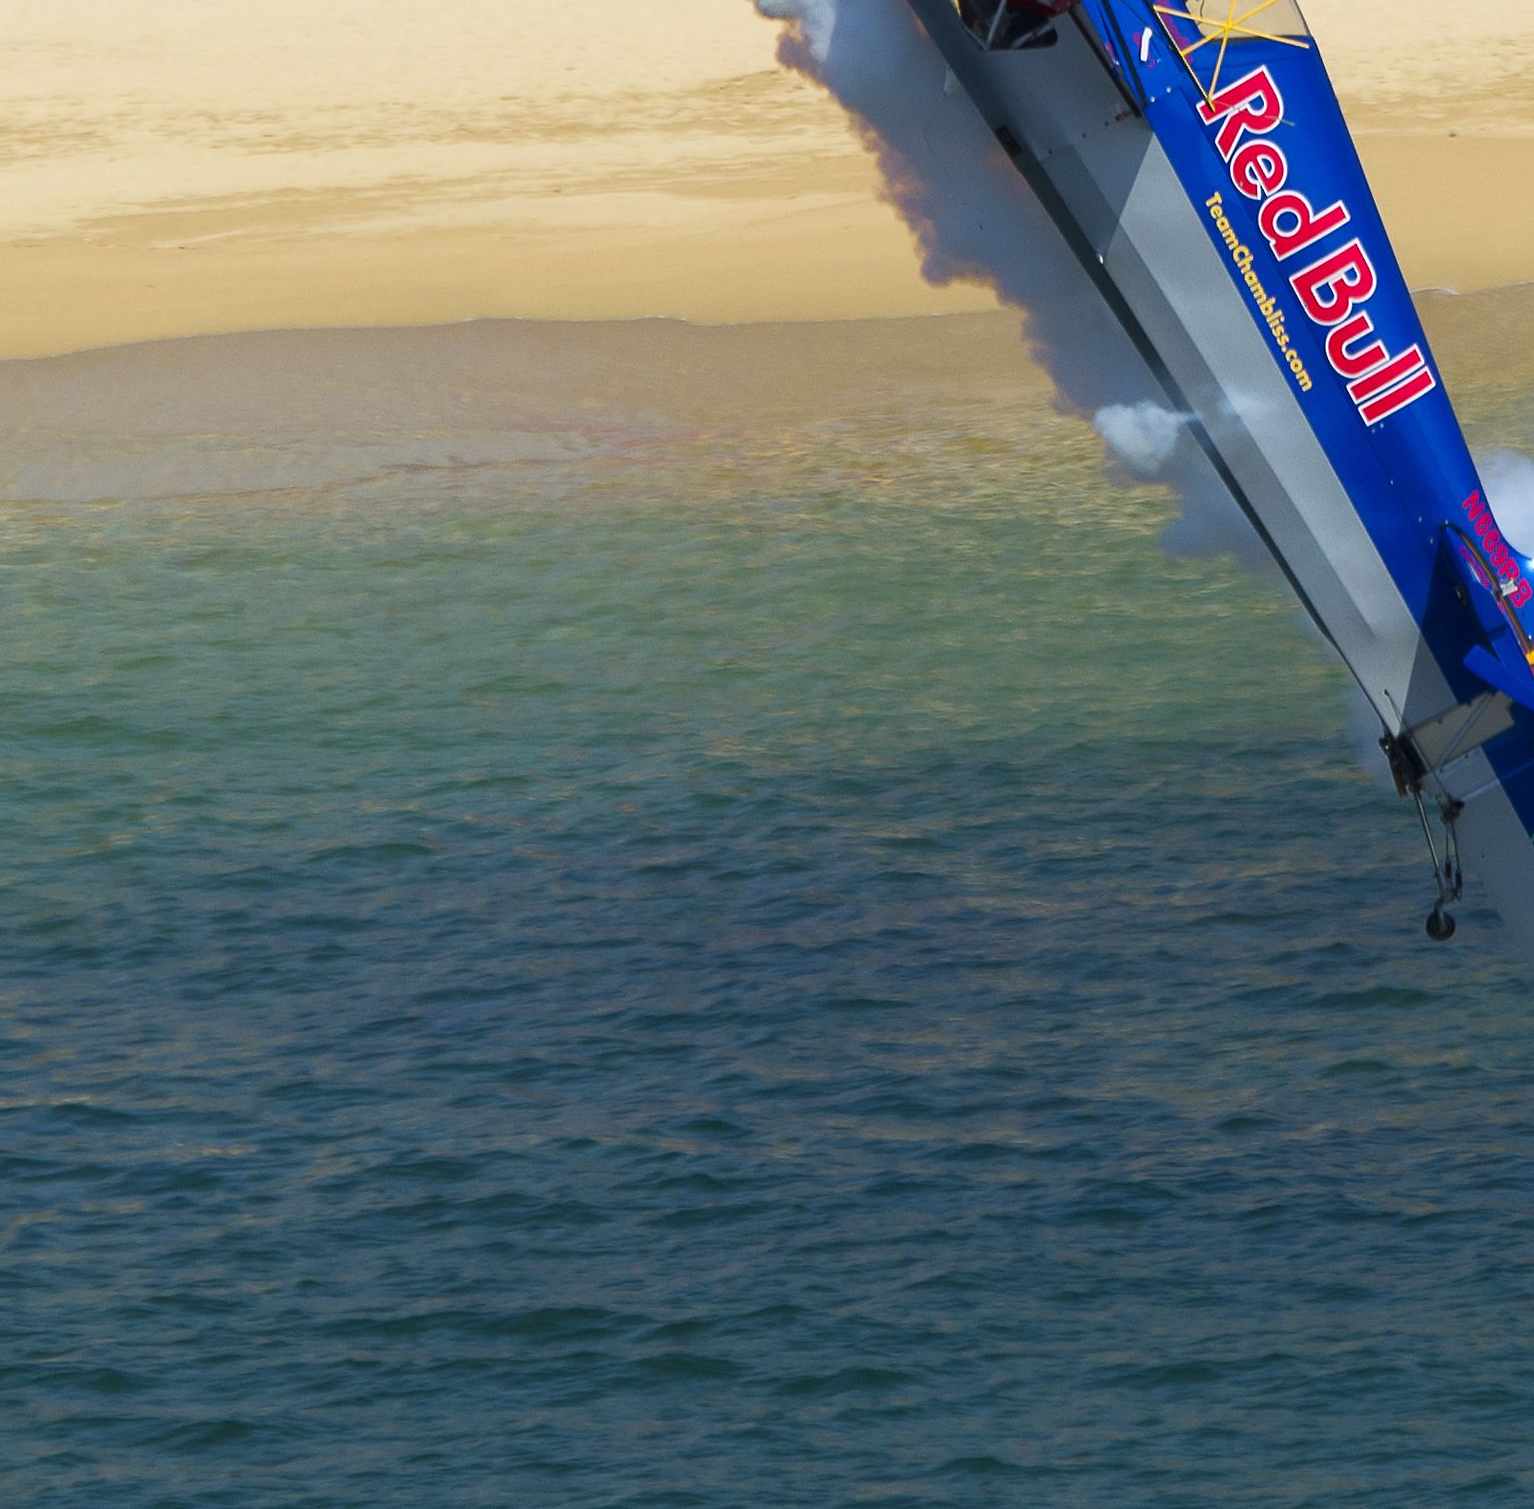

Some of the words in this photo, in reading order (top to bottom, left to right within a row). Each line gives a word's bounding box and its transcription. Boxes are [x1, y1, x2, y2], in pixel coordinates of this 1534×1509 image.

[1196, 64, 1350, 261] Red
[1288, 237, 1436, 427] Bull
[1205, 191, 1313, 393] TeamChambliss.com
[1462, 490, 1533, 608] N669RB
